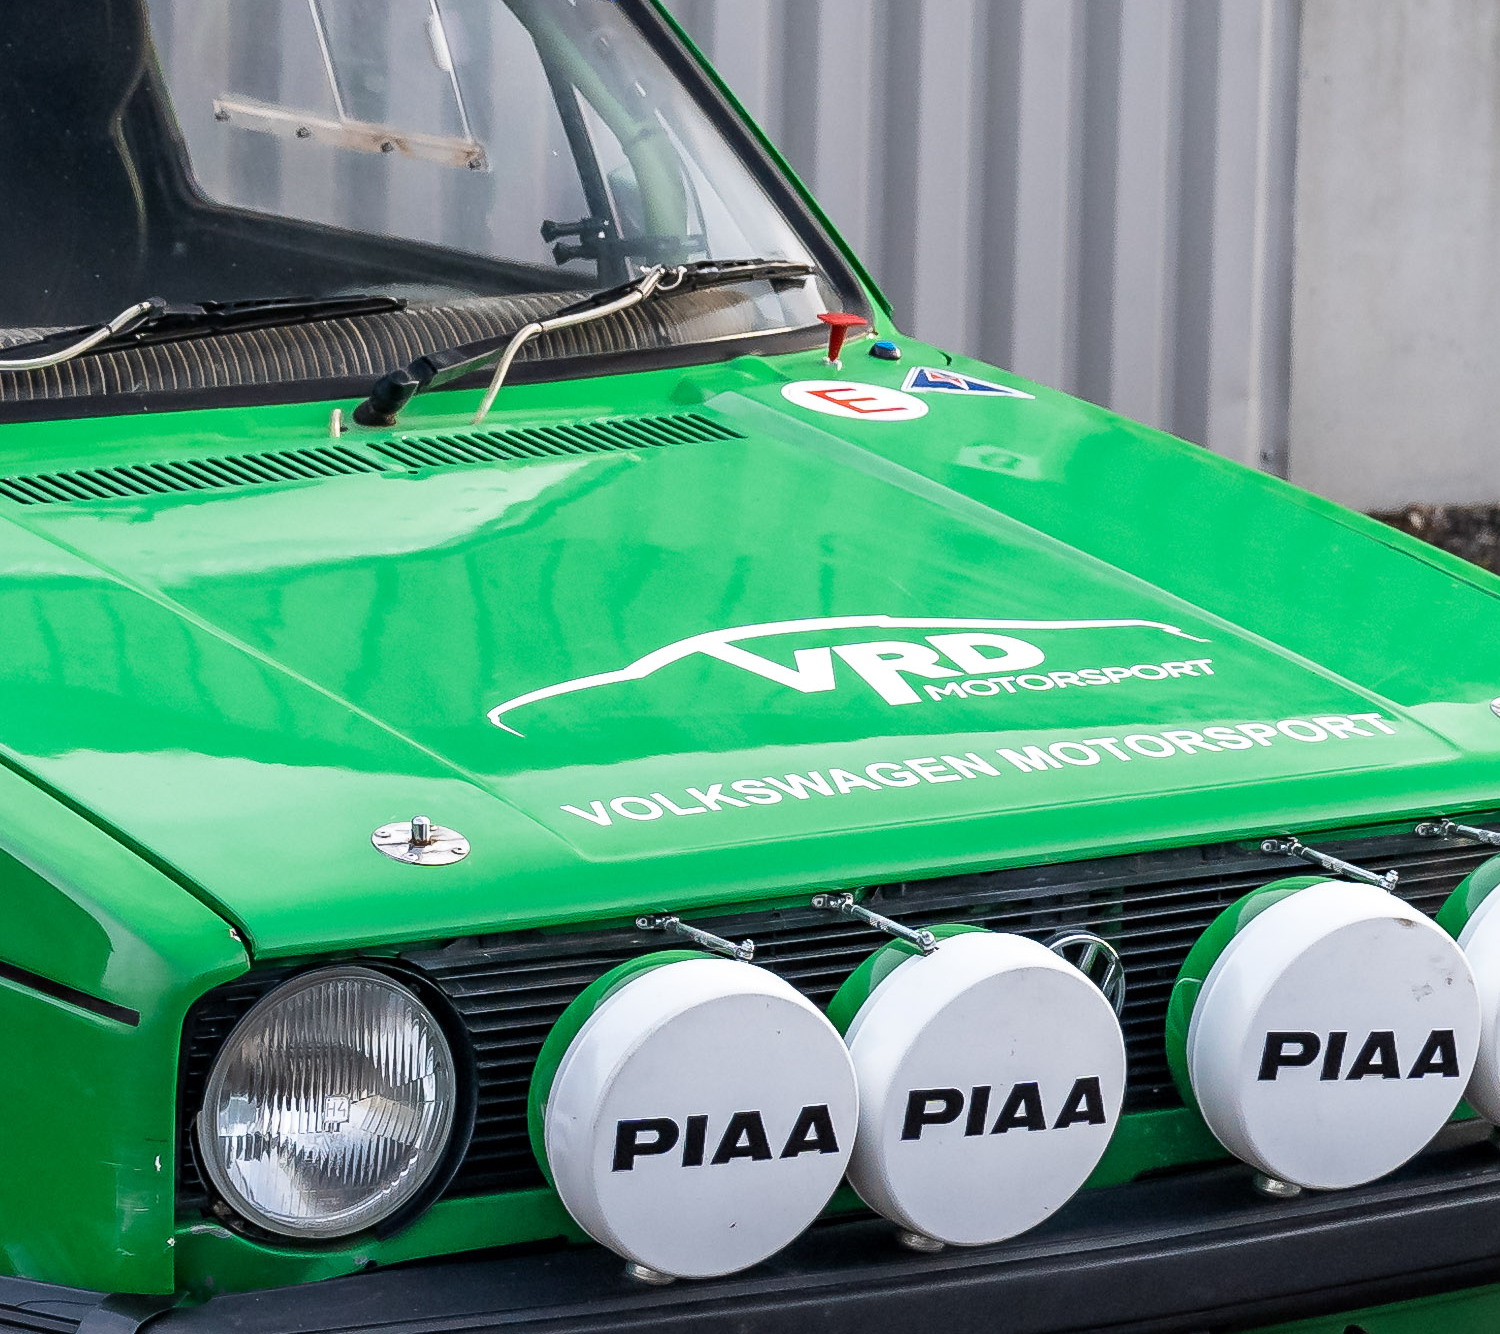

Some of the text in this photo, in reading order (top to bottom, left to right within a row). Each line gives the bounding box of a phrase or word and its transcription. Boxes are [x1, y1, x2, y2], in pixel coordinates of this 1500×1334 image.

[695, 632, 1046, 706] VRD
[922, 658, 1216, 703] MOTORSPORT
[558, 711, 1397, 827] VOLKSWAGEN MOTORSPORT
[1256, 1028, 1461, 1083] PIAA
[610, 1103, 841, 1174] PIAA
[899, 1075, 1107, 1142] PIAA
